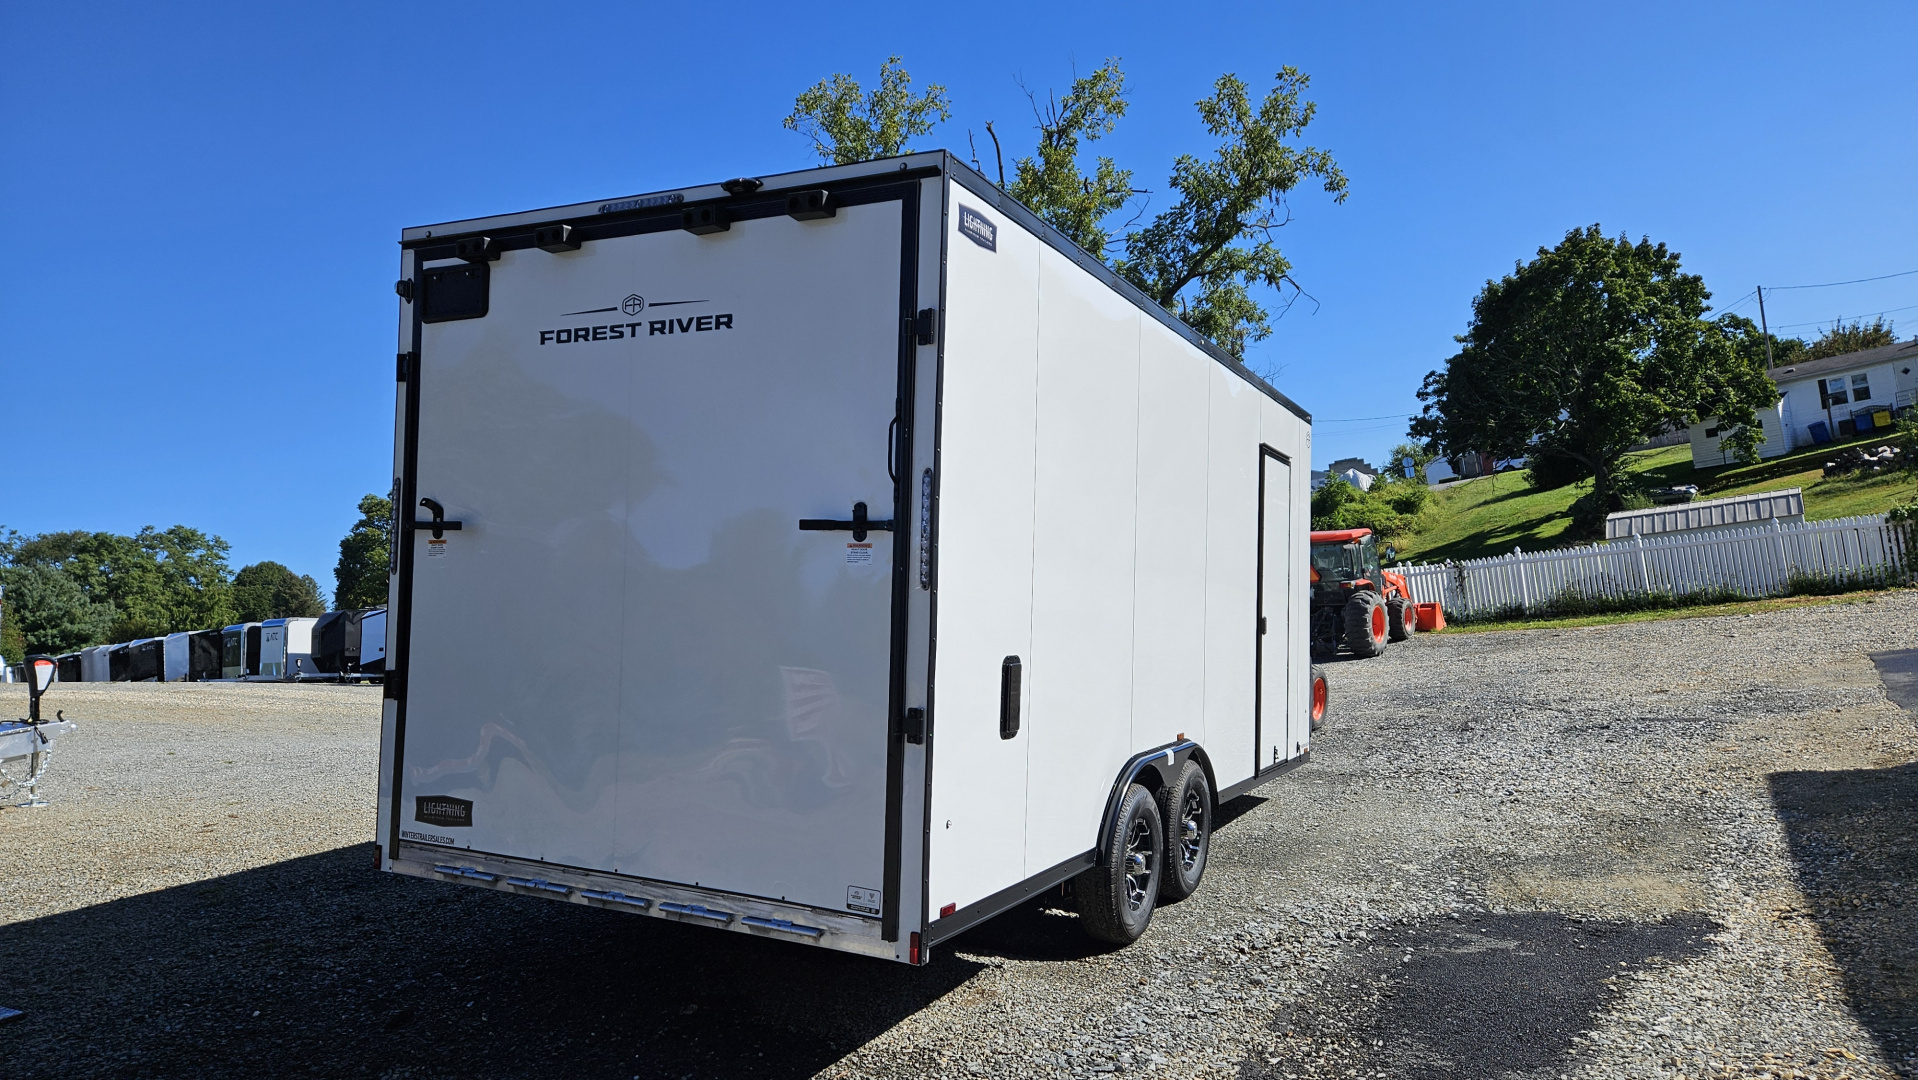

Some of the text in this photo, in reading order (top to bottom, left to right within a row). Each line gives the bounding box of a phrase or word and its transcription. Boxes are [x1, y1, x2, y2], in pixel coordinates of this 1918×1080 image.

[964, 211, 993, 241] LIGHTNING
[539, 313, 734, 345] FOREST RIVER
[423, 801, 466, 817] LIGHTNING
[401, 830, 455, 846] WINTERSTRAILERSALES.COM
